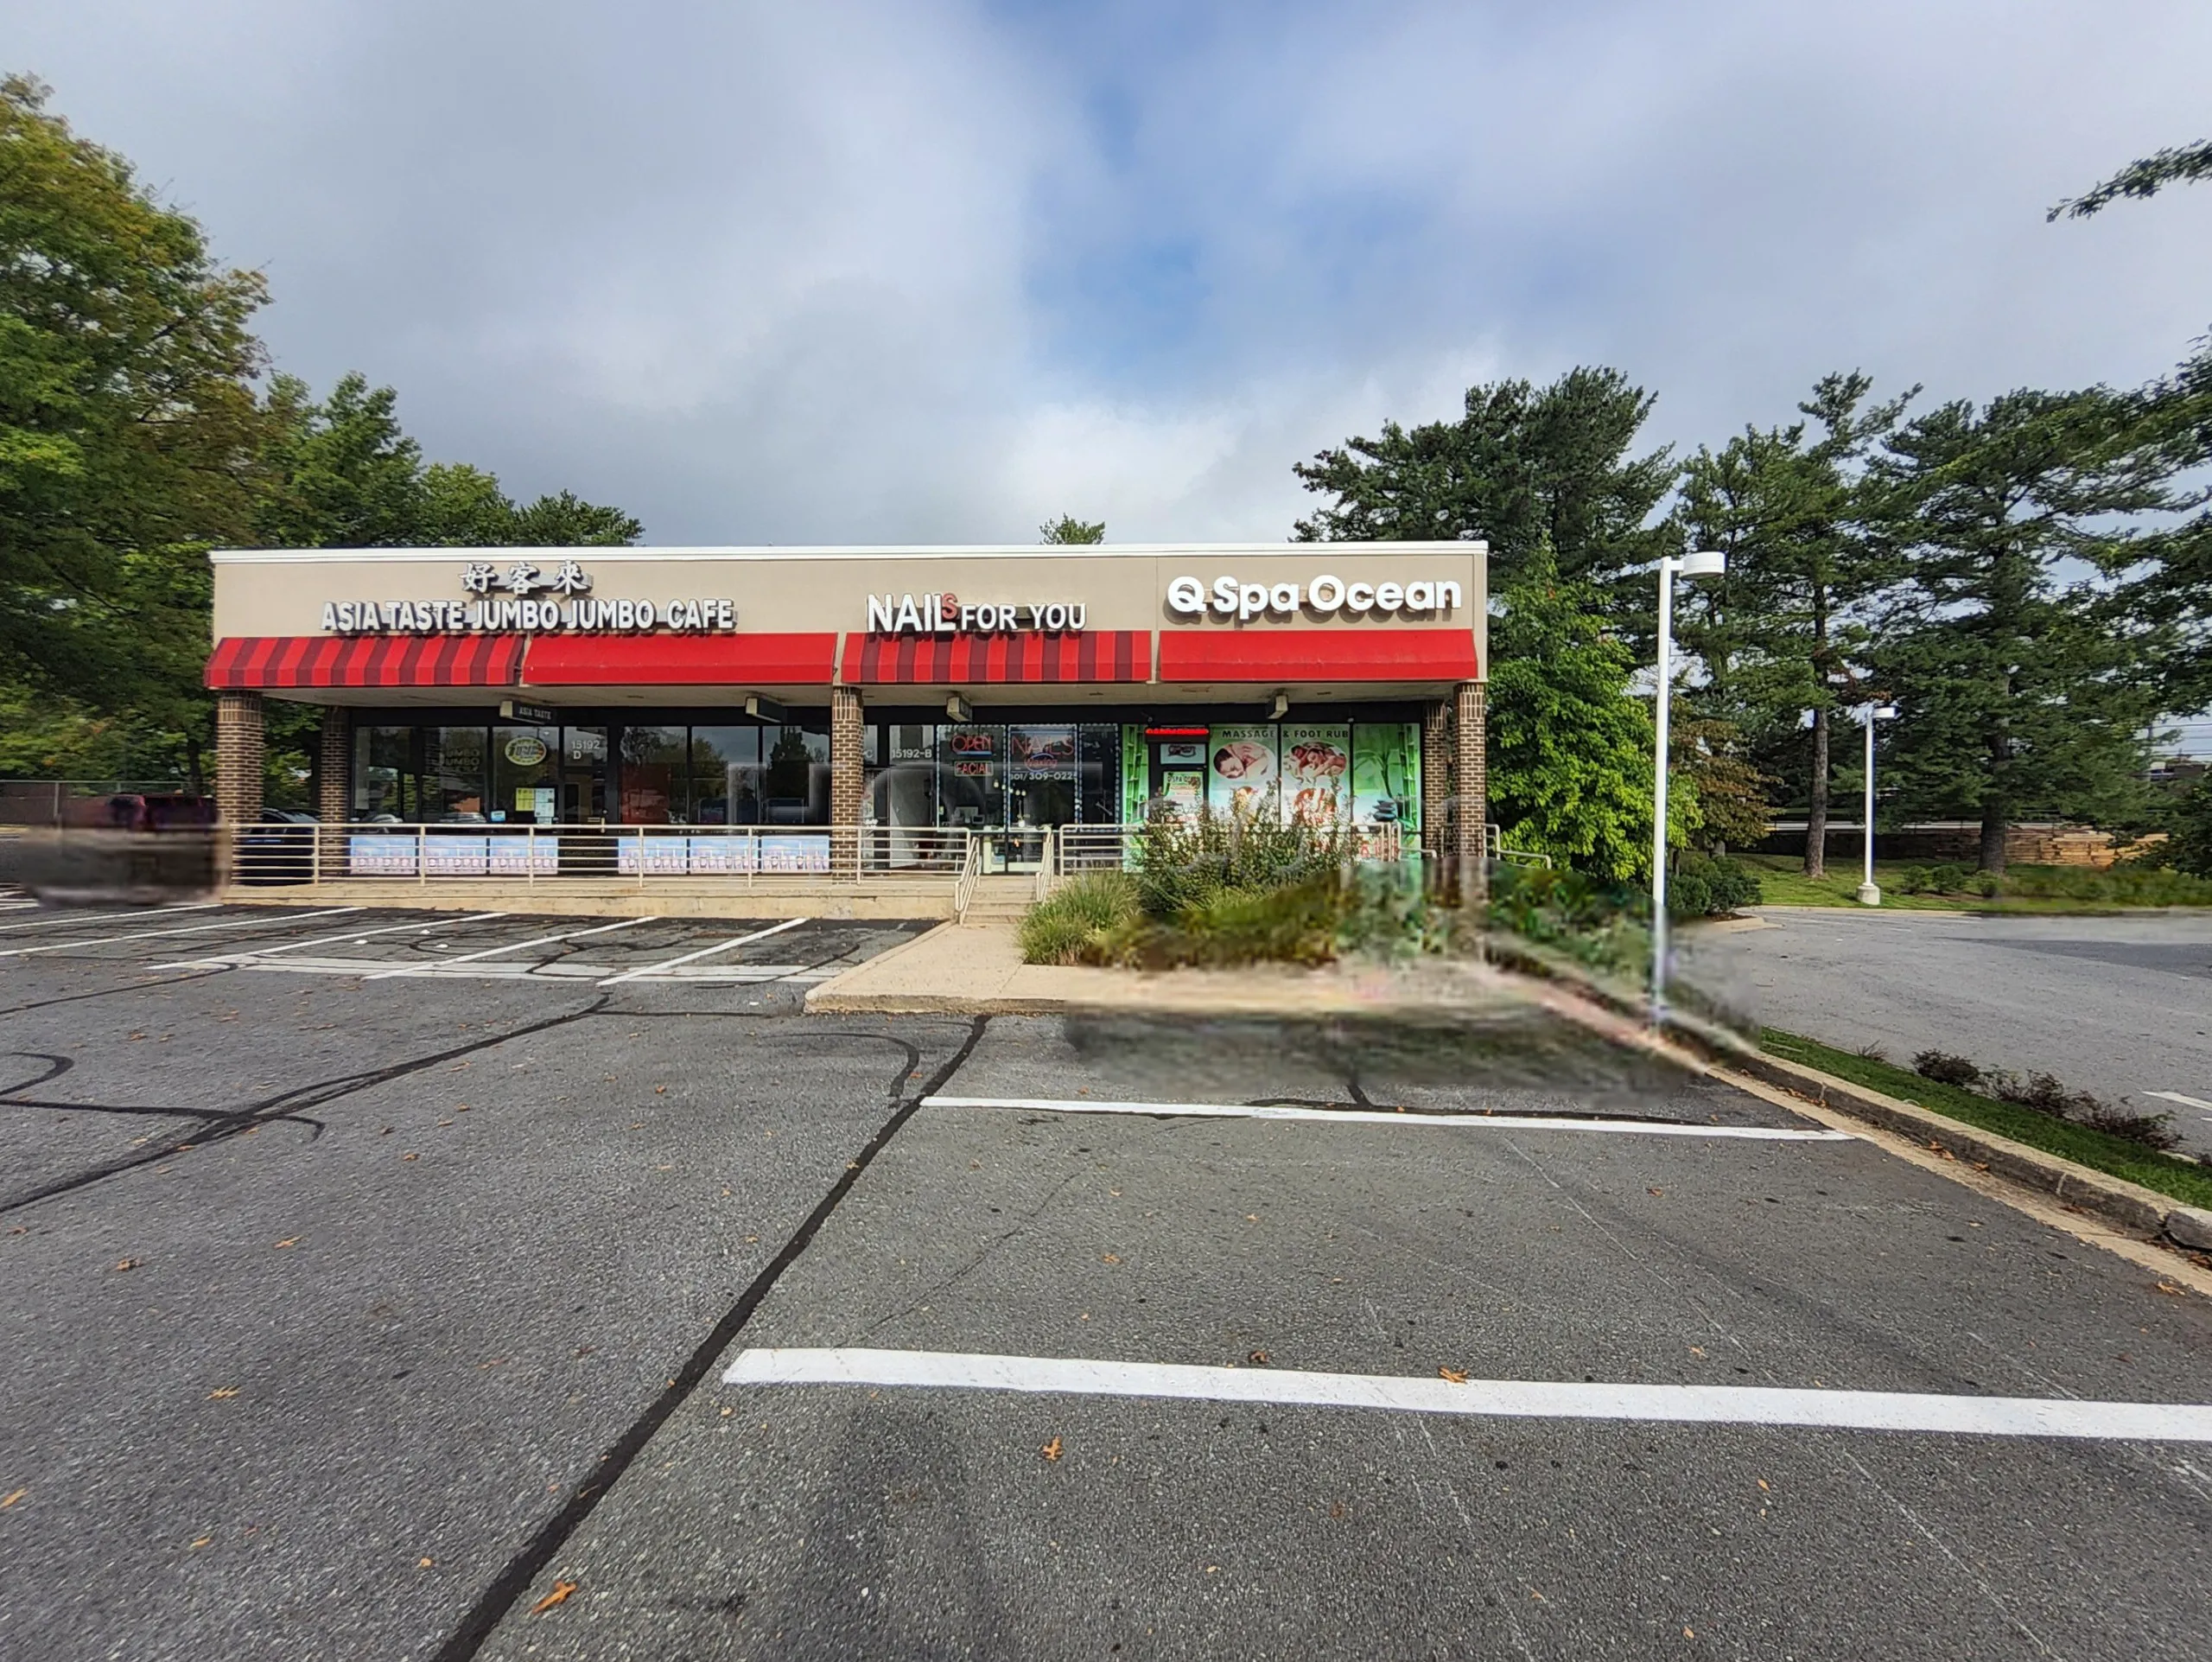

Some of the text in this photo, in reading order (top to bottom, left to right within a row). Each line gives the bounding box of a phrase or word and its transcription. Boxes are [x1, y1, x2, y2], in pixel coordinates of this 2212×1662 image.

[460, 559, 588, 595] 好客來
[1167, 575, 1461, 620] Q Spa Ocean
[321, 599, 734, 631] ASIA TASTE JUMBO JUMBO CAFE
[867, 592, 1086, 633] NAILS FOR YOU
[1222, 729, 1275, 739] MASSAGE
[571, 740, 601, 749] 15192
[951, 735, 992, 752] OPEN
[1011, 735, 1075, 755] NAILS
[573, 750, 582, 760] D
[891, 748, 932, 759] 15192-B
[956, 762, 991, 775] FACIAL
